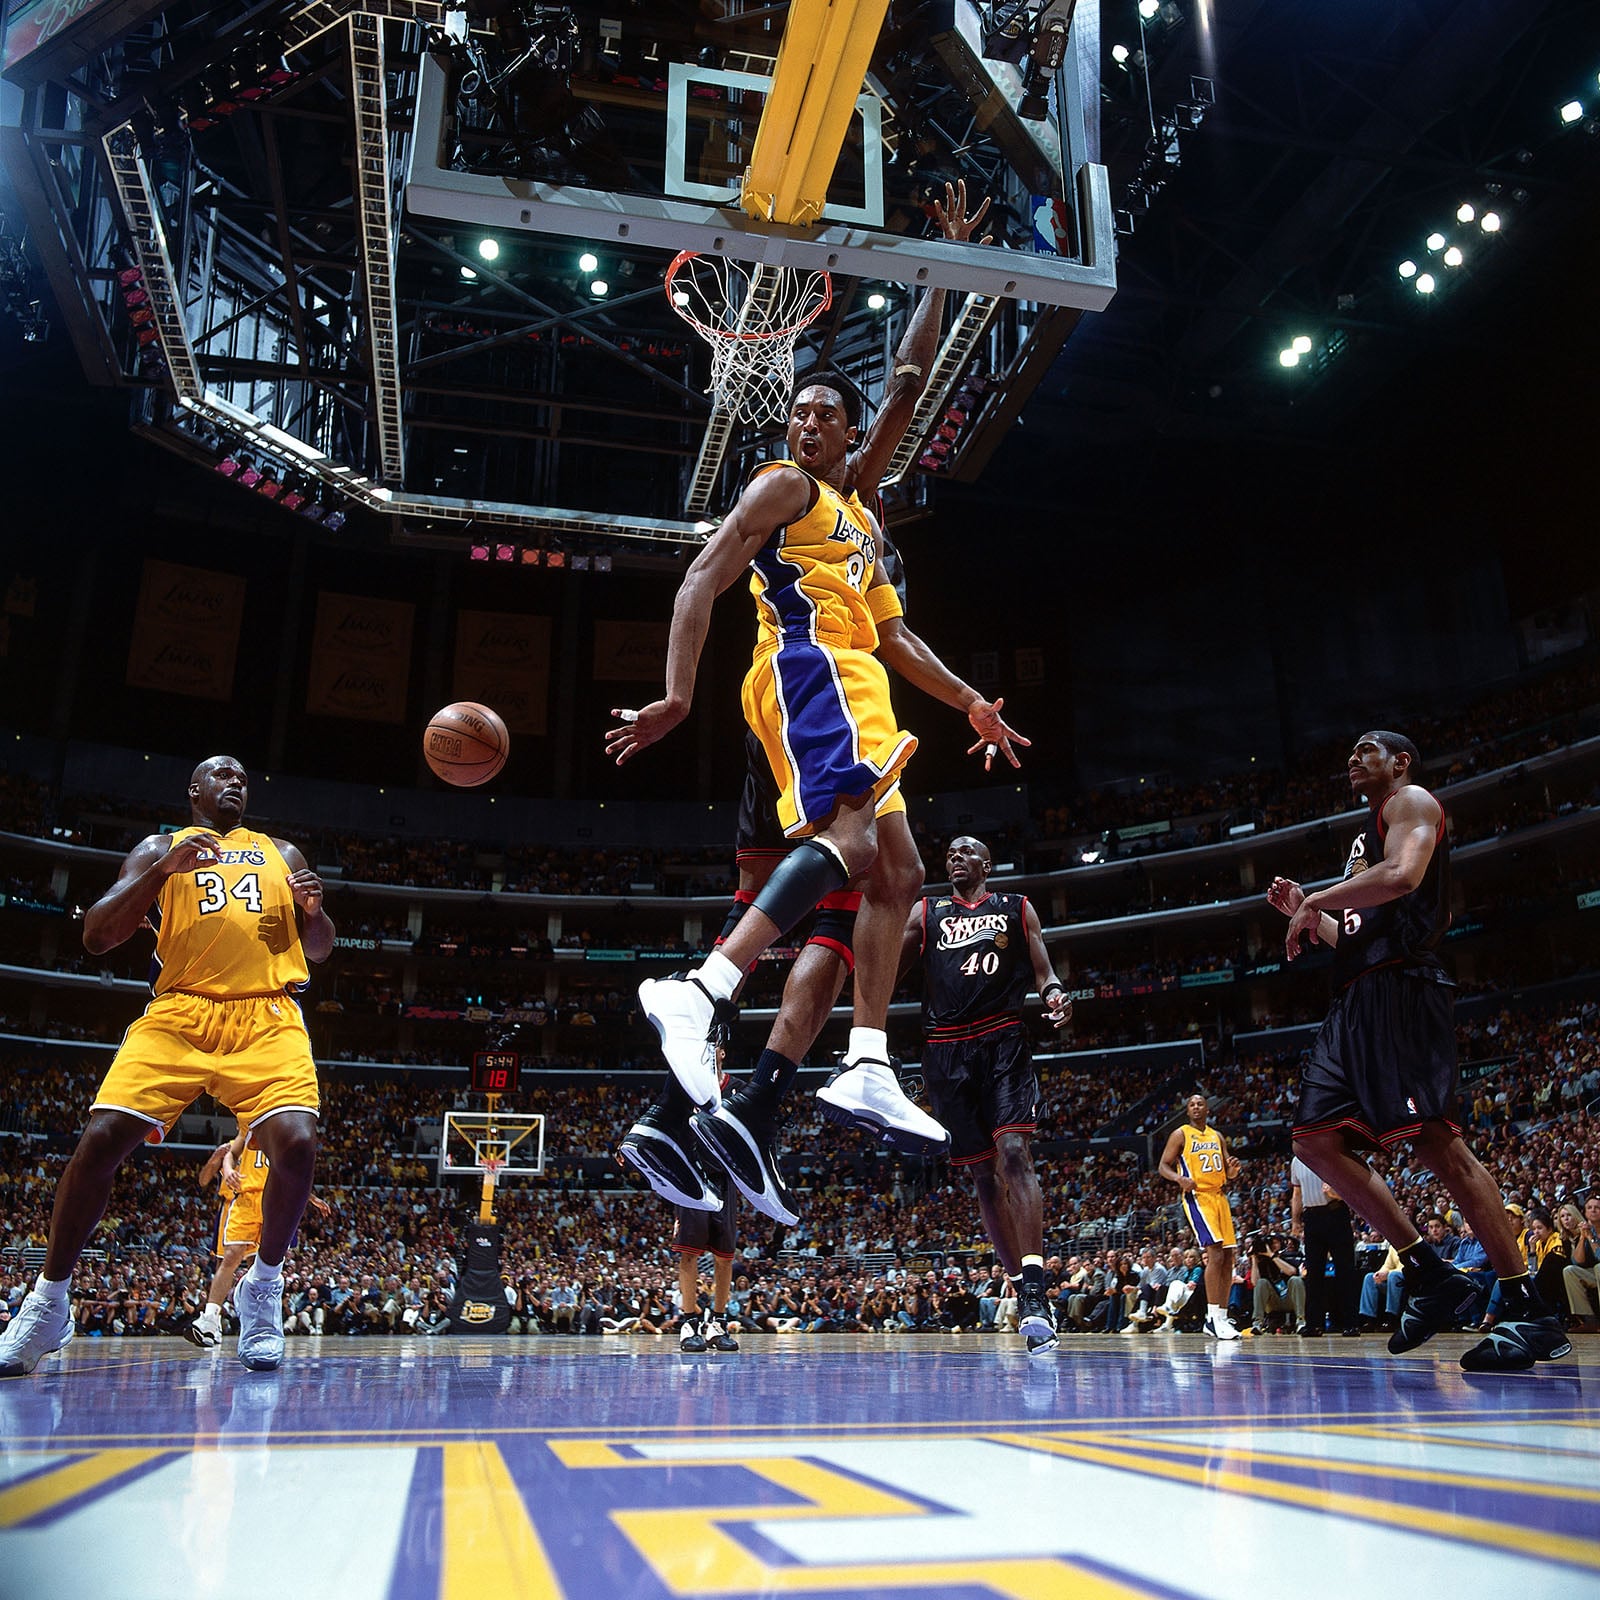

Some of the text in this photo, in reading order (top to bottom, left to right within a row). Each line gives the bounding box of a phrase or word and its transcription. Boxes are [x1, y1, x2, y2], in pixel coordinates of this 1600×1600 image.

[846, 551, 866, 595] 8
[197, 850, 266, 866] AERS
[195, 872, 263, 915] 34
[938, 913, 1009, 946] SIXERS
[333, 937, 376, 951] STAPLES
[959, 951, 1000, 977] 40
[1256, 963, 1280, 975] PEPSI
[1067, 988, 1095, 1001] APLES
[486, 1055, 514, 1067] 5:44
[489, 1070, 508, 1088] 18
[1191, 1141, 1220, 1153] LAKERS
[1198, 1152, 1224, 1173] 20
